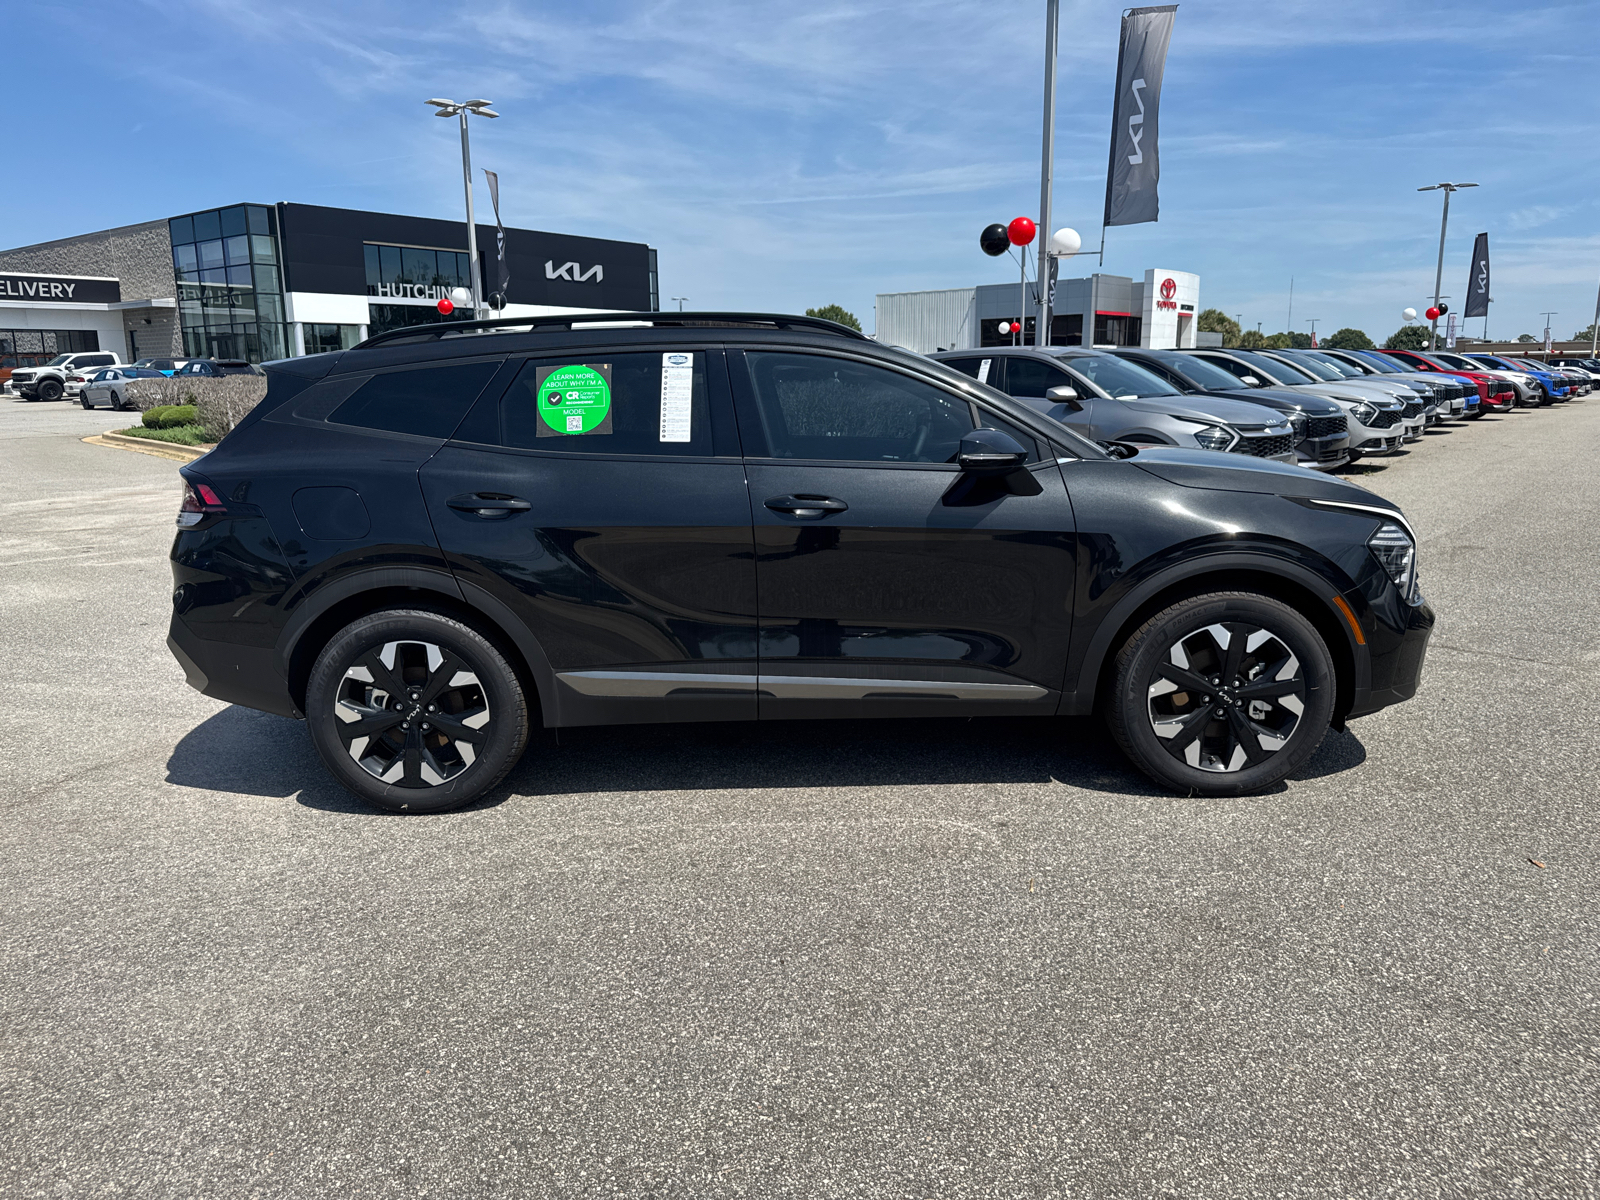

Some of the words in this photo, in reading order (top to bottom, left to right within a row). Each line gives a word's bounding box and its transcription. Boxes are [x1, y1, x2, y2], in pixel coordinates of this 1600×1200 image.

[545, 260, 603, 283] KIA
[378, 282, 472, 303] HUTCHIN
[566, 391, 579, 399] CR
